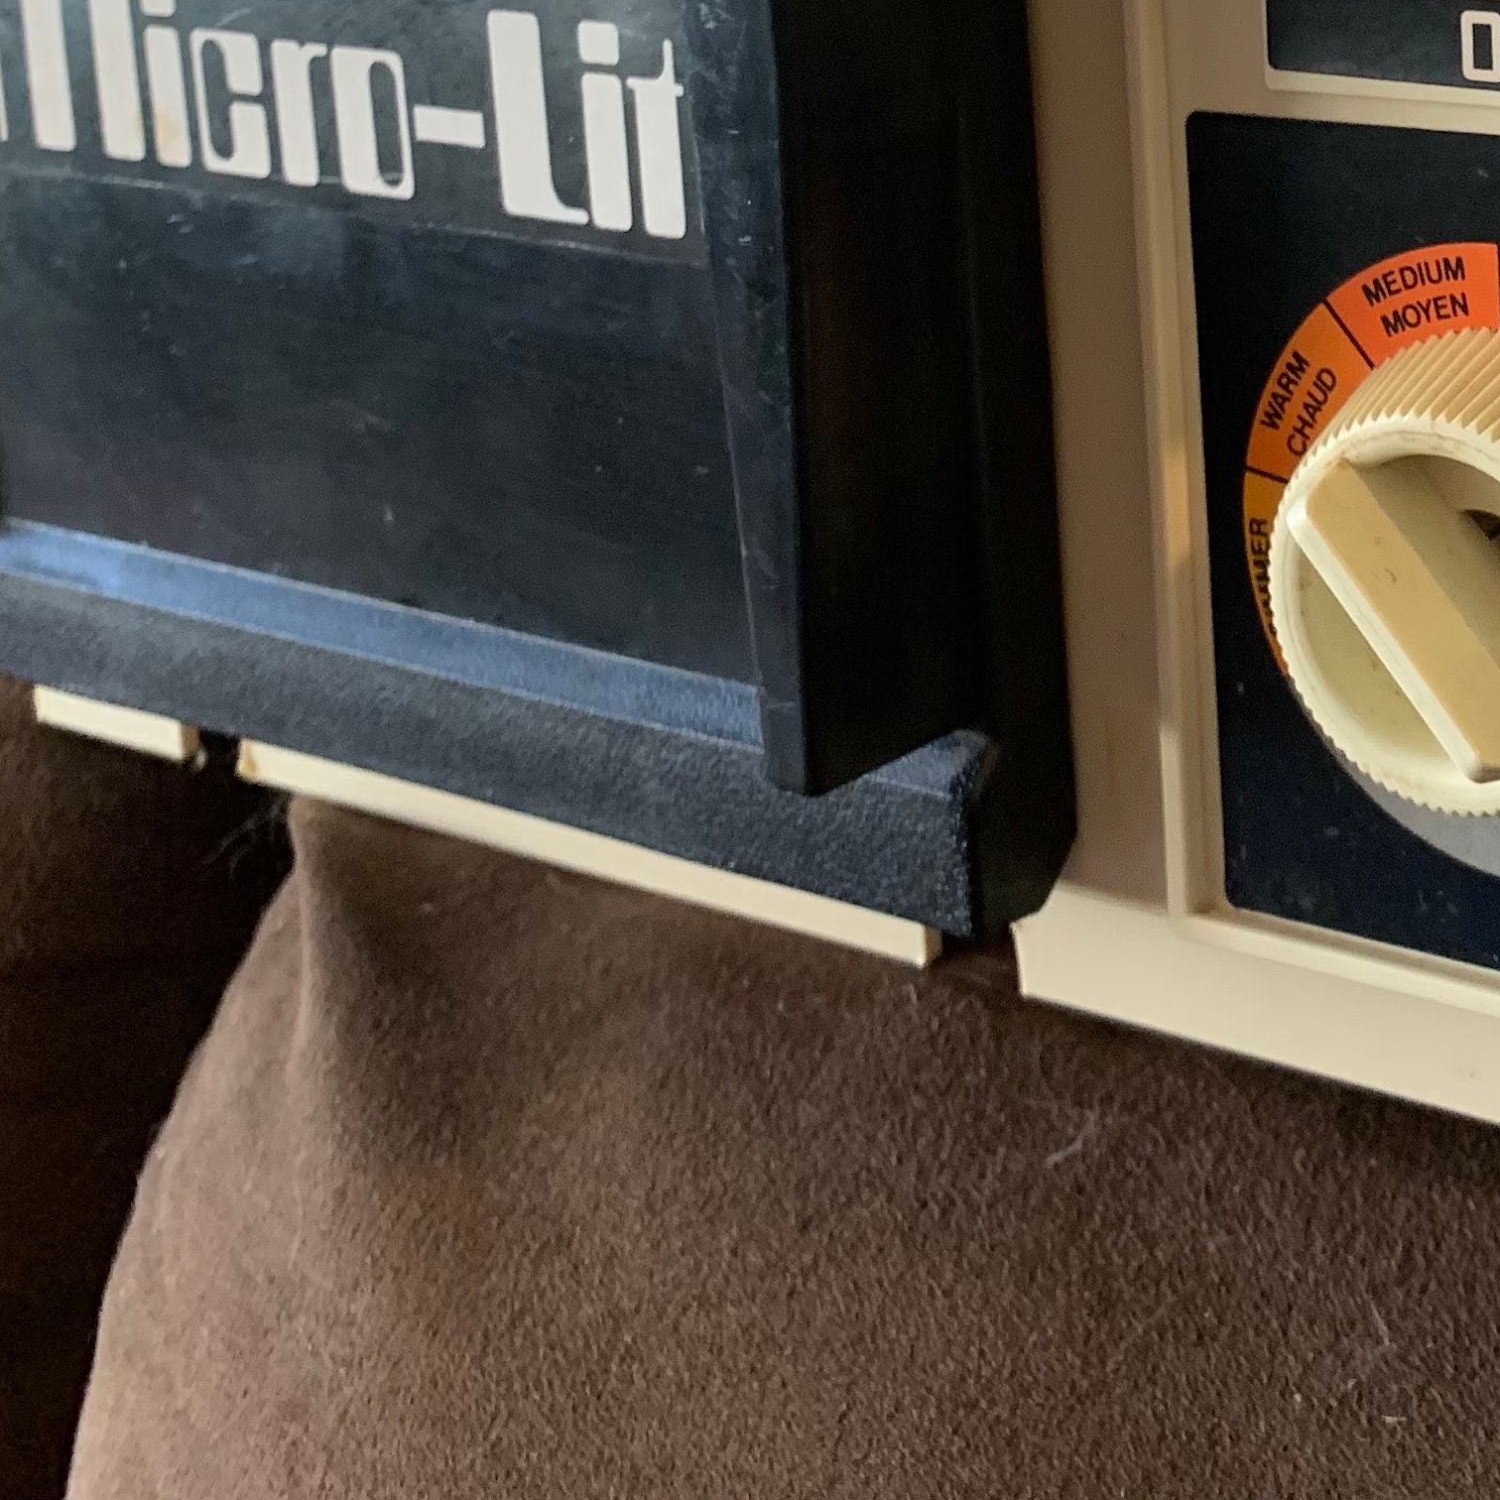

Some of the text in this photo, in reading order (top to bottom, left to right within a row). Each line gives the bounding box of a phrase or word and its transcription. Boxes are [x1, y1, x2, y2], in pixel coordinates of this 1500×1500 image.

[1361, 255, 1467, 308] MEDIUM
[1379, 291, 1470, 338] MOYEN
[1259, 351, 1311, 432] WARM
[1286, 367, 1338, 458] CHAUD
